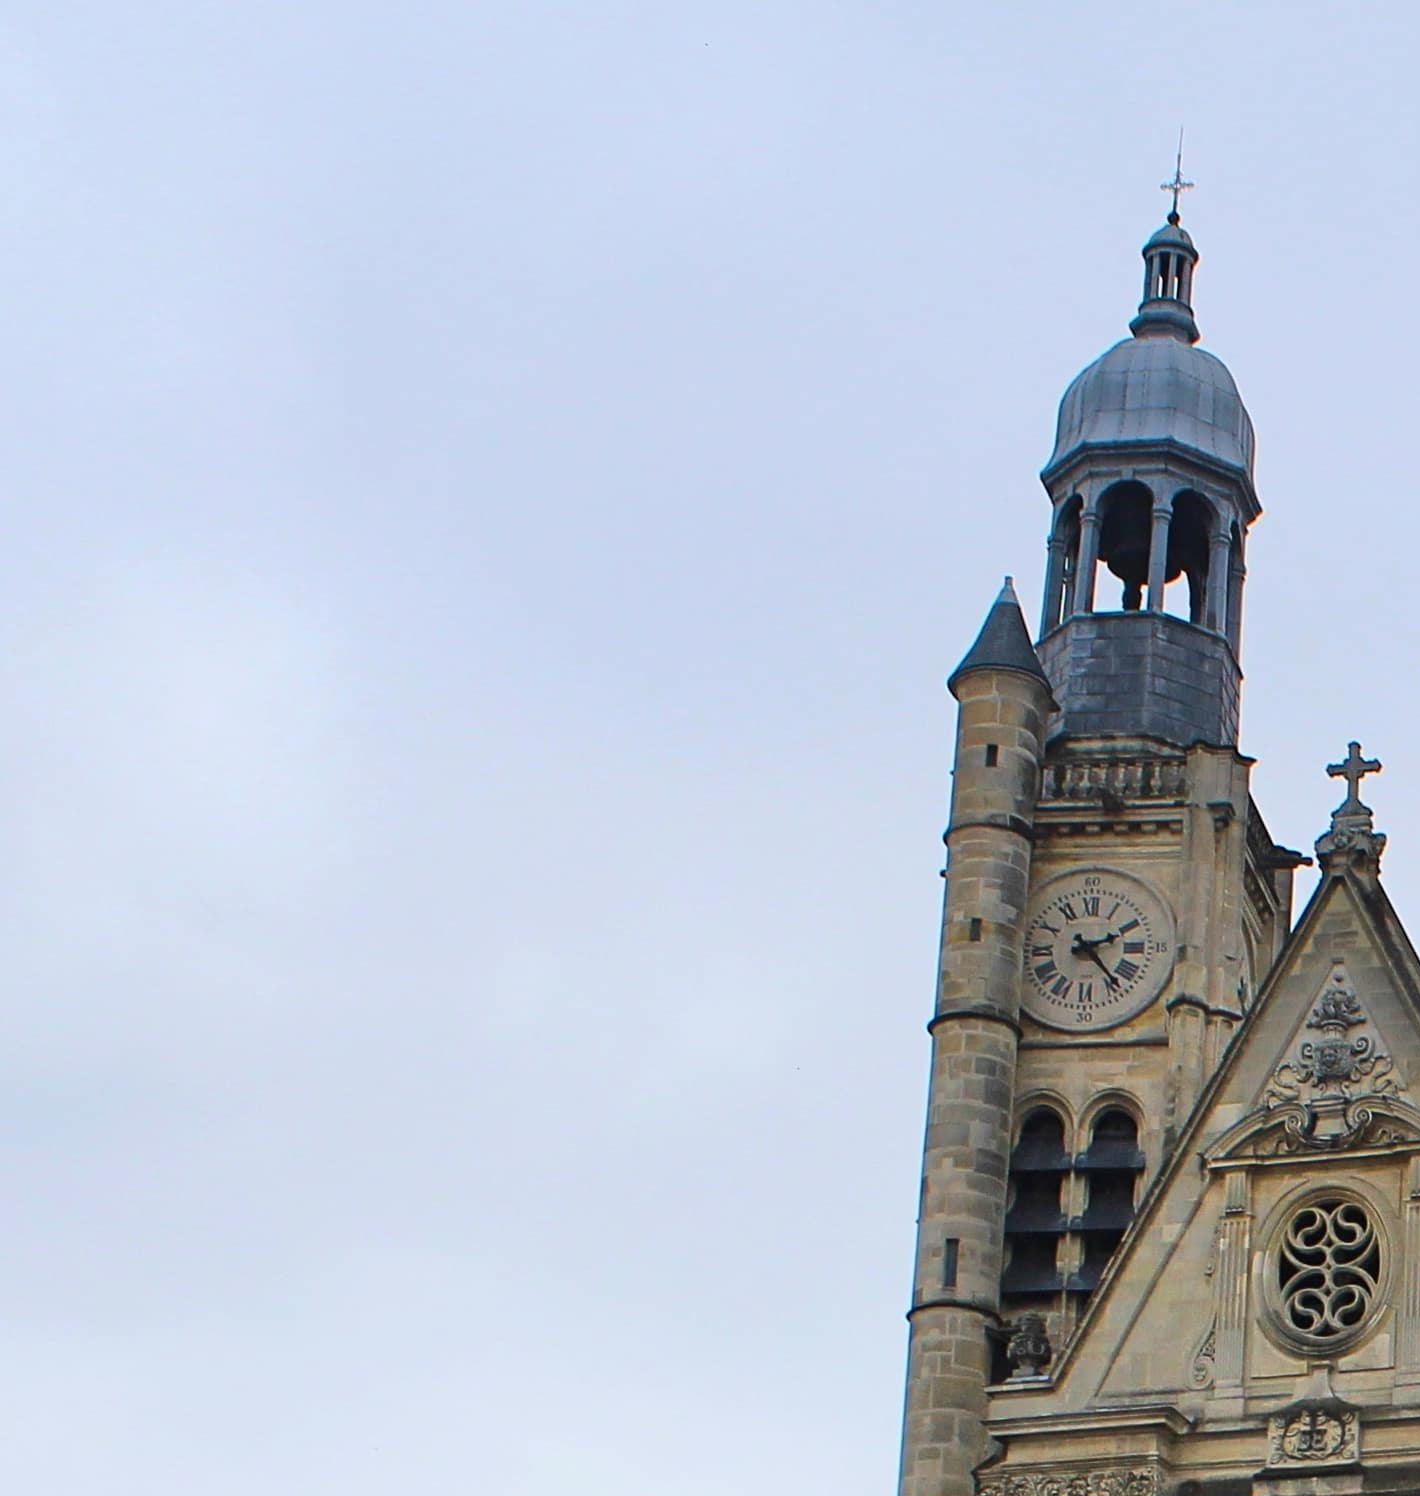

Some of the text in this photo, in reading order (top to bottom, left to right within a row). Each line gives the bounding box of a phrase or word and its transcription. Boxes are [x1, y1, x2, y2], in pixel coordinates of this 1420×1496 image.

[1085, 877, 1101, 886] 60
[1059, 902, 1078, 925] XI
[1083, 896, 1100, 917] XII
[1106, 902, 1121, 921] I
[1155, 942, 1168, 953] 15
[1078, 982, 1093, 1003] VI
[1076, 1012, 1093, 1023] 30
